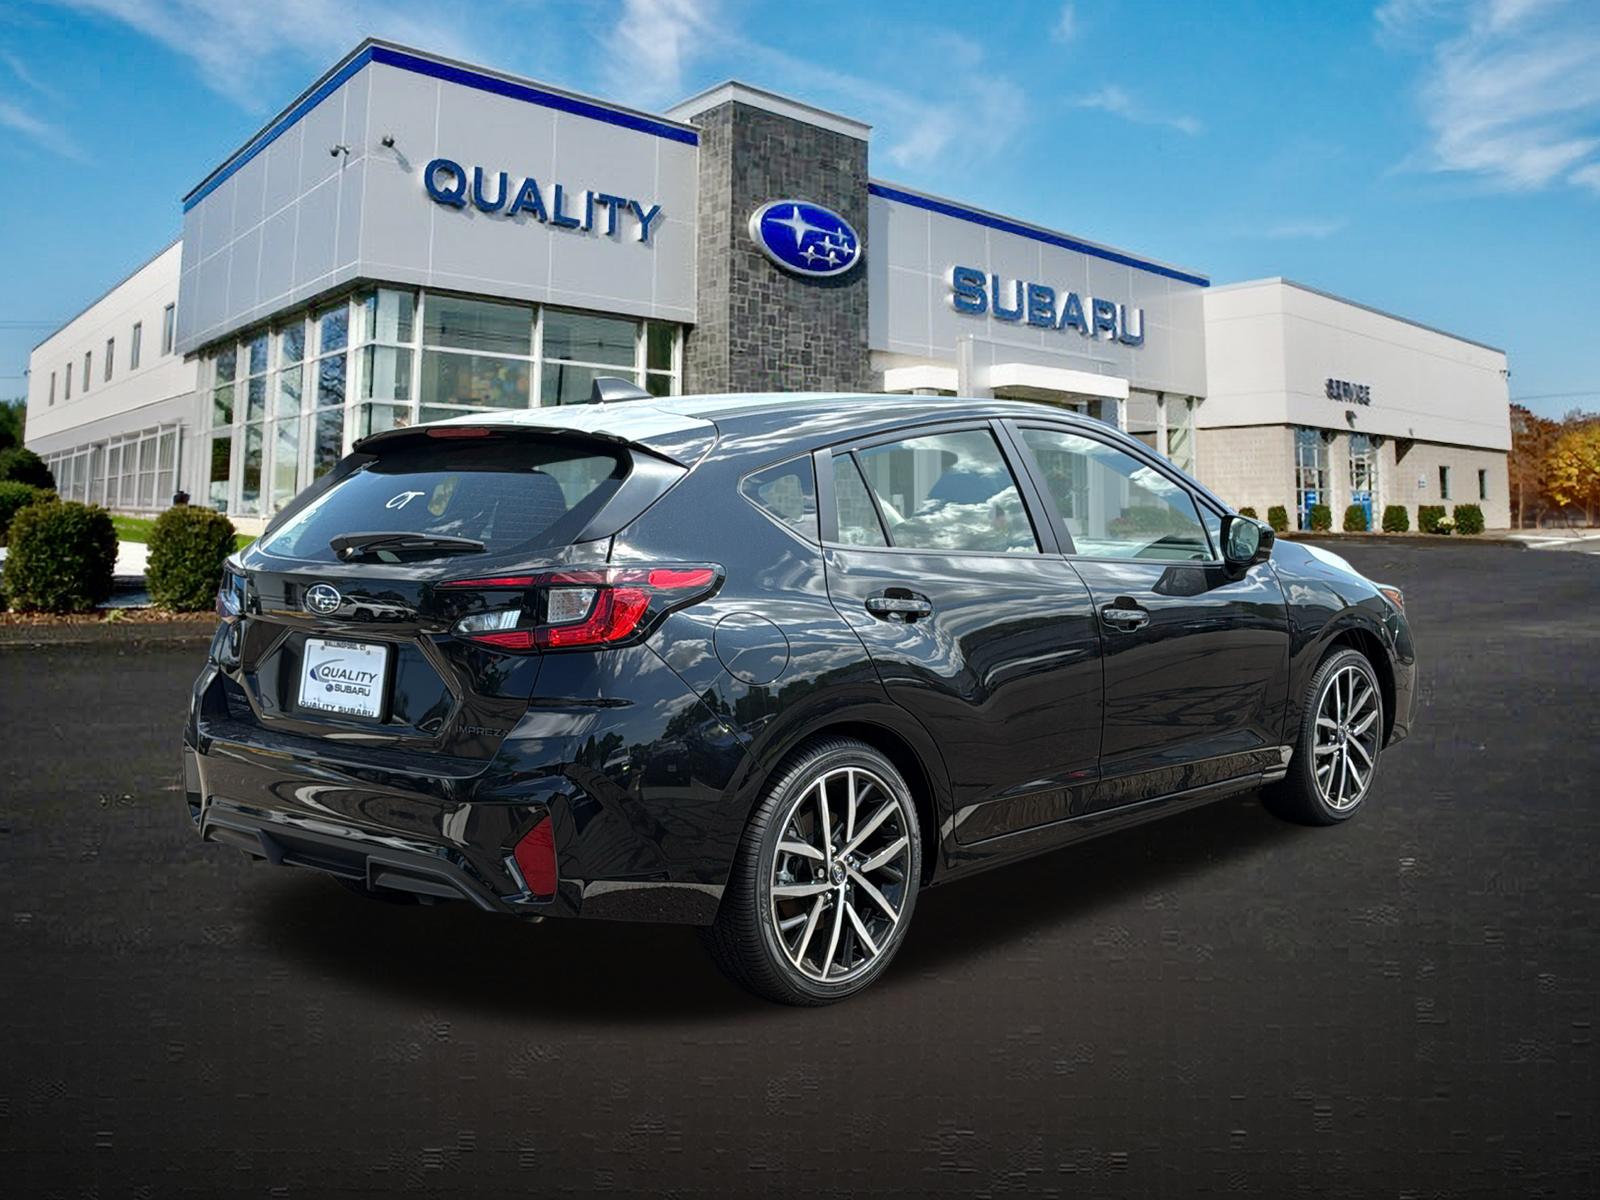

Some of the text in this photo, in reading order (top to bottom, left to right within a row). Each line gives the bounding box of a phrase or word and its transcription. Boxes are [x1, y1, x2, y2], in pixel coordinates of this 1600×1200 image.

[424, 158, 661, 243] QUALITY
[952, 265, 1144, 346] SUBARU
[321, 666, 378, 683] QUALITY
[334, 684, 371, 697] SUBARU
[300, 700, 374, 717] QUALITY SUBARU
